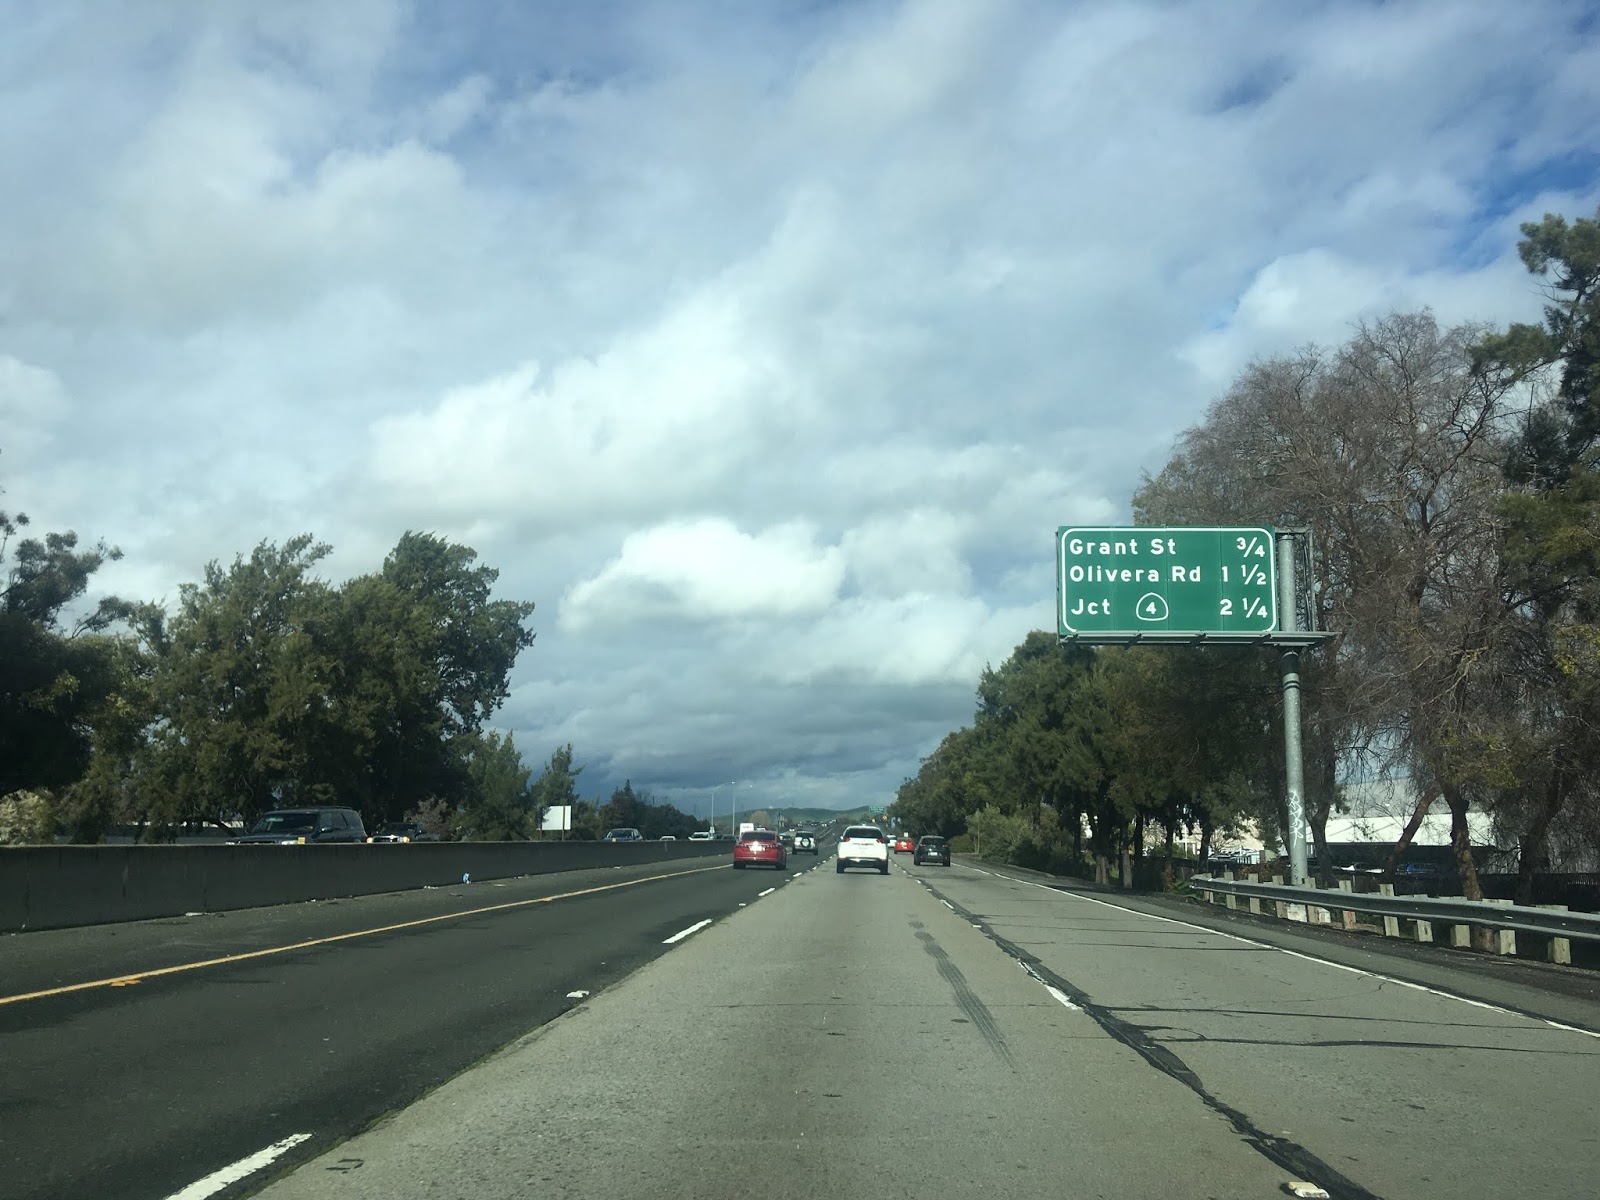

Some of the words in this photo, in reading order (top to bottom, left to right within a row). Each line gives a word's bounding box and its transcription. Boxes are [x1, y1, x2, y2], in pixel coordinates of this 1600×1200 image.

[1069, 538, 1138, 555] Grant
[1150, 538, 1176, 555] St
[1069, 565, 1160, 582] Olivera
[1171, 565, 1201, 582] Rd
[1221, 565, 1229, 582] 1
[1070, 598, 1111, 616] Jct
[1145, 601, 1157, 615] 4
[1219, 598, 1233, 616] 2
